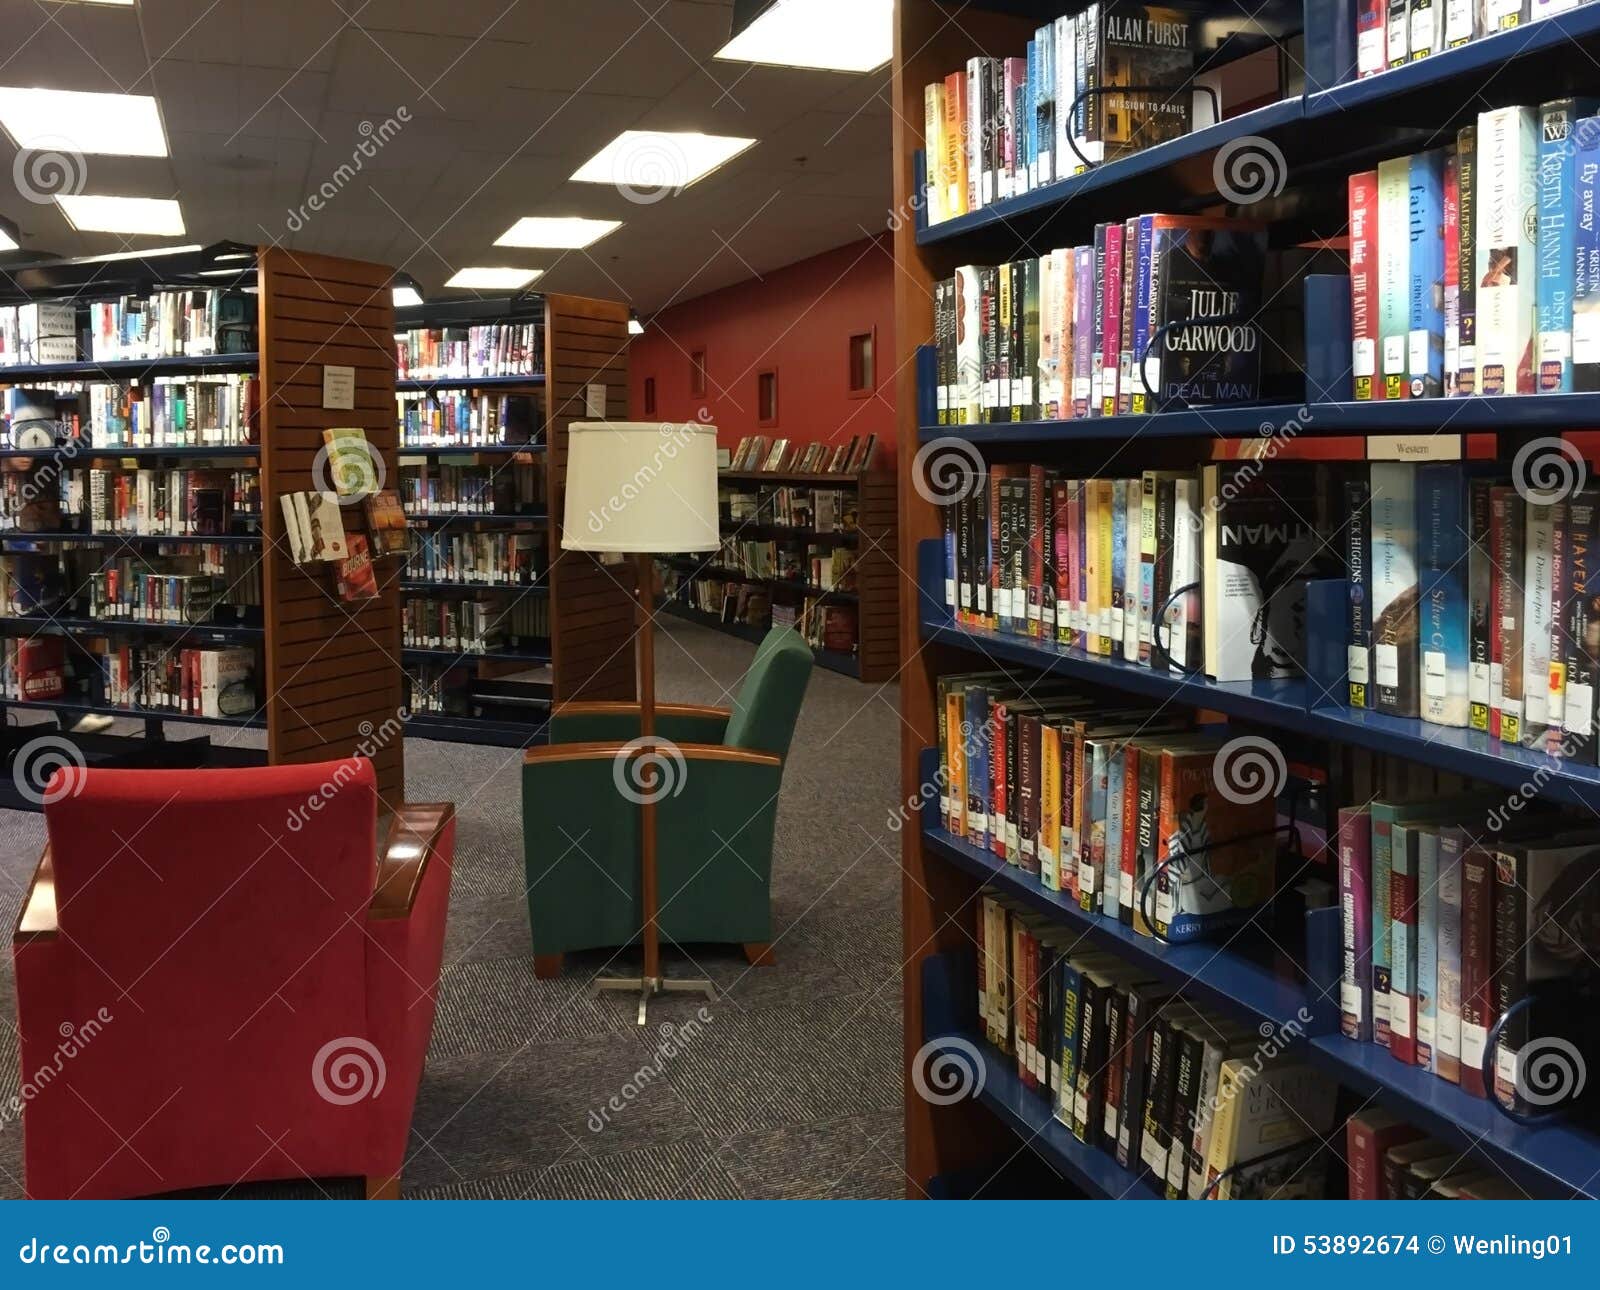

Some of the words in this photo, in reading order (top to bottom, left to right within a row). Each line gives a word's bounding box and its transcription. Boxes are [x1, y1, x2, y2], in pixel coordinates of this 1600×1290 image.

[1107, 15, 1142, 42] ALAN
[1145, 20, 1189, 48] FURST
[1108, 98, 1145, 111] MISSION
[1148, 102, 1159, 112] TO
[1161, 103, 1186, 115] PARIS
[1460, 162, 1471, 191] THE
[1541, 153, 1566, 209] KRISTIN
[1580, 163, 1598, 188] fly
[1350, 209, 1368, 238] Brian
[1409, 184, 1427, 245] faith
[1460, 193, 1471, 242] MALTESE
[1580, 190, 1598, 235] away
[1107, 234, 1120, 263] Julie
[1136, 222, 1151, 252] Julie
[1541, 214, 1566, 282] HANNAH
[1094, 246, 1105, 276] Julie
[1148, 250, 1160, 276] JULIE
[1460, 245, 1471, 294] FALCON
[1576, 246, 1586, 298] HANNAH
[1589, 250, 1600, 293] KRISTIN
[1107, 265, 1120, 320] Garwood
[1136, 254, 1151, 310] Garwood
[1350, 272, 1368, 292] THE
[1411, 274, 1423, 325] JENNIFER
[988, 296, 997, 317] LISA
[1094, 279, 1105, 336] Garwood
[1121, 249, 1134, 353] HEARTBREAKER
[1148, 278, 1160, 325] GARWOOD
[1187, 289, 1240, 321] JULIE
[1350, 295, 1368, 341] KINGMA
[1552, 291, 1566, 333] DISTA
[988, 319, 997, 363] GARDNER
[1165, 321, 1256, 353] GARWOOD
[1164, 382, 1211, 400] IDEAL
[1215, 382, 1258, 400] MAN
[1355, 378, 1370, 389] LP
[1386, 376, 1400, 388] LP
[1396, 443, 1430, 455] Western
[1018, 506, 1026, 528] LAST
[1350, 509, 1362, 534] JACK
[959, 525, 971, 560] George
[1000, 521, 1010, 555] COLD
[1044, 517, 1052, 566] GERRITSEN
[1551, 530, 1564, 551] RAY
[1350, 536, 1362, 584] HIGGINS
[1551, 552, 1564, 592] HOGAN
[1570, 531, 1588, 595] HAVEN
[1532, 555, 1548, 627] Dovekeepers
[1350, 606, 1362, 636] ROUGH
[1429, 589, 1445, 631] Silver
[1551, 599, 1564, 630] TALL
[1551, 634, 1564, 663] MAN
[1352, 685, 1364, 696] LP
[1473, 704, 1486, 718] LP
[1502, 716, 1517, 732] LP
[1021, 742, 1030, 784] GRAFTON
[1021, 786, 1032, 800] R
[1138, 788, 1152, 810] The
[1138, 811, 1152, 848] YARD
[1342, 892, 1356, 949] COMPROMISING
[1342, 950, 1356, 988] POSITION
[1063, 988, 1077, 1040] Griffin
[1081, 1002, 1094, 1049] Griffin
[1111, 1006, 1120, 1048] Griffin
[1150, 1030, 1163, 1078] Griffin
[1183, 1059, 1191, 1095] MARTHA
